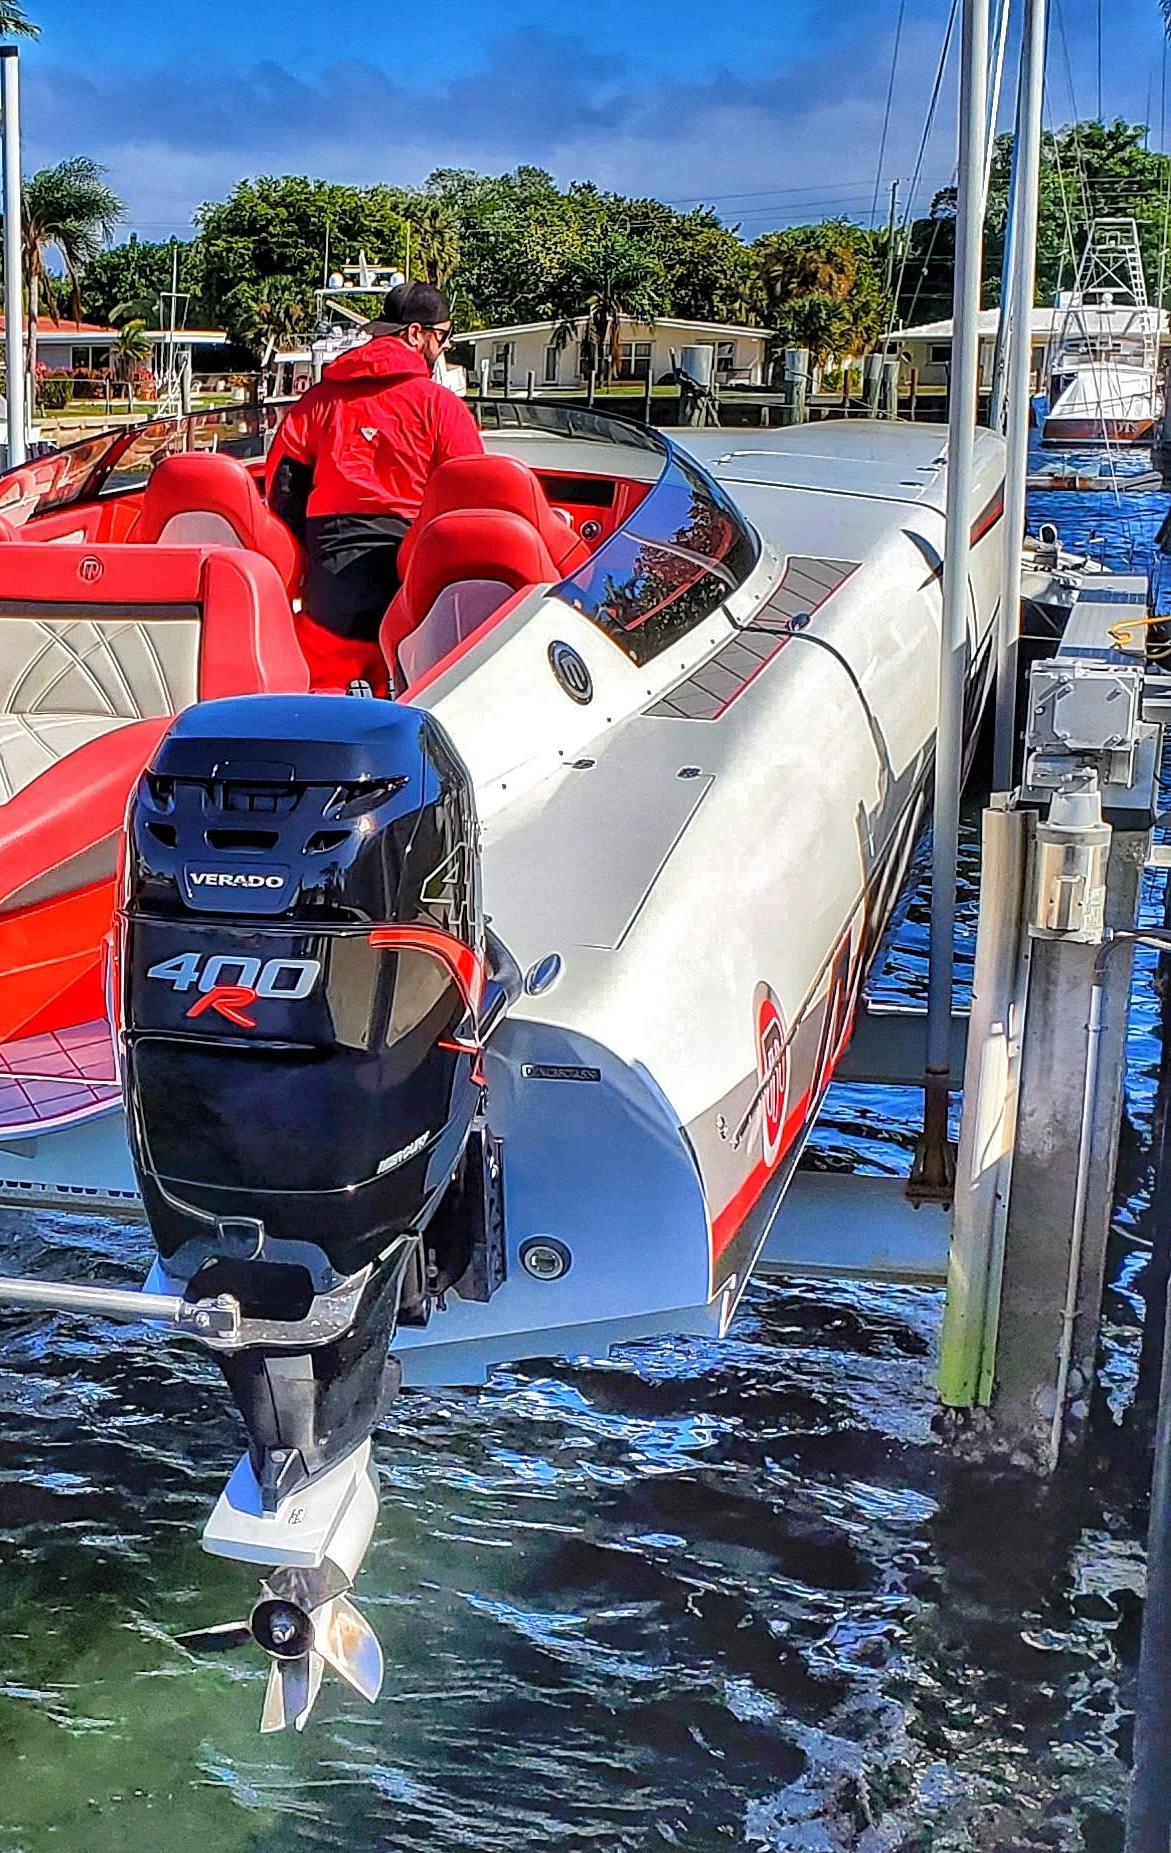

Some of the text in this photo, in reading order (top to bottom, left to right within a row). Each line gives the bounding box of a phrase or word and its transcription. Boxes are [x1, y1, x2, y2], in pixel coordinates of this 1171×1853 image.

[189, 873, 284, 888] VERADO
[147, 952, 321, 999] 400
[185, 985, 256, 1029] R
